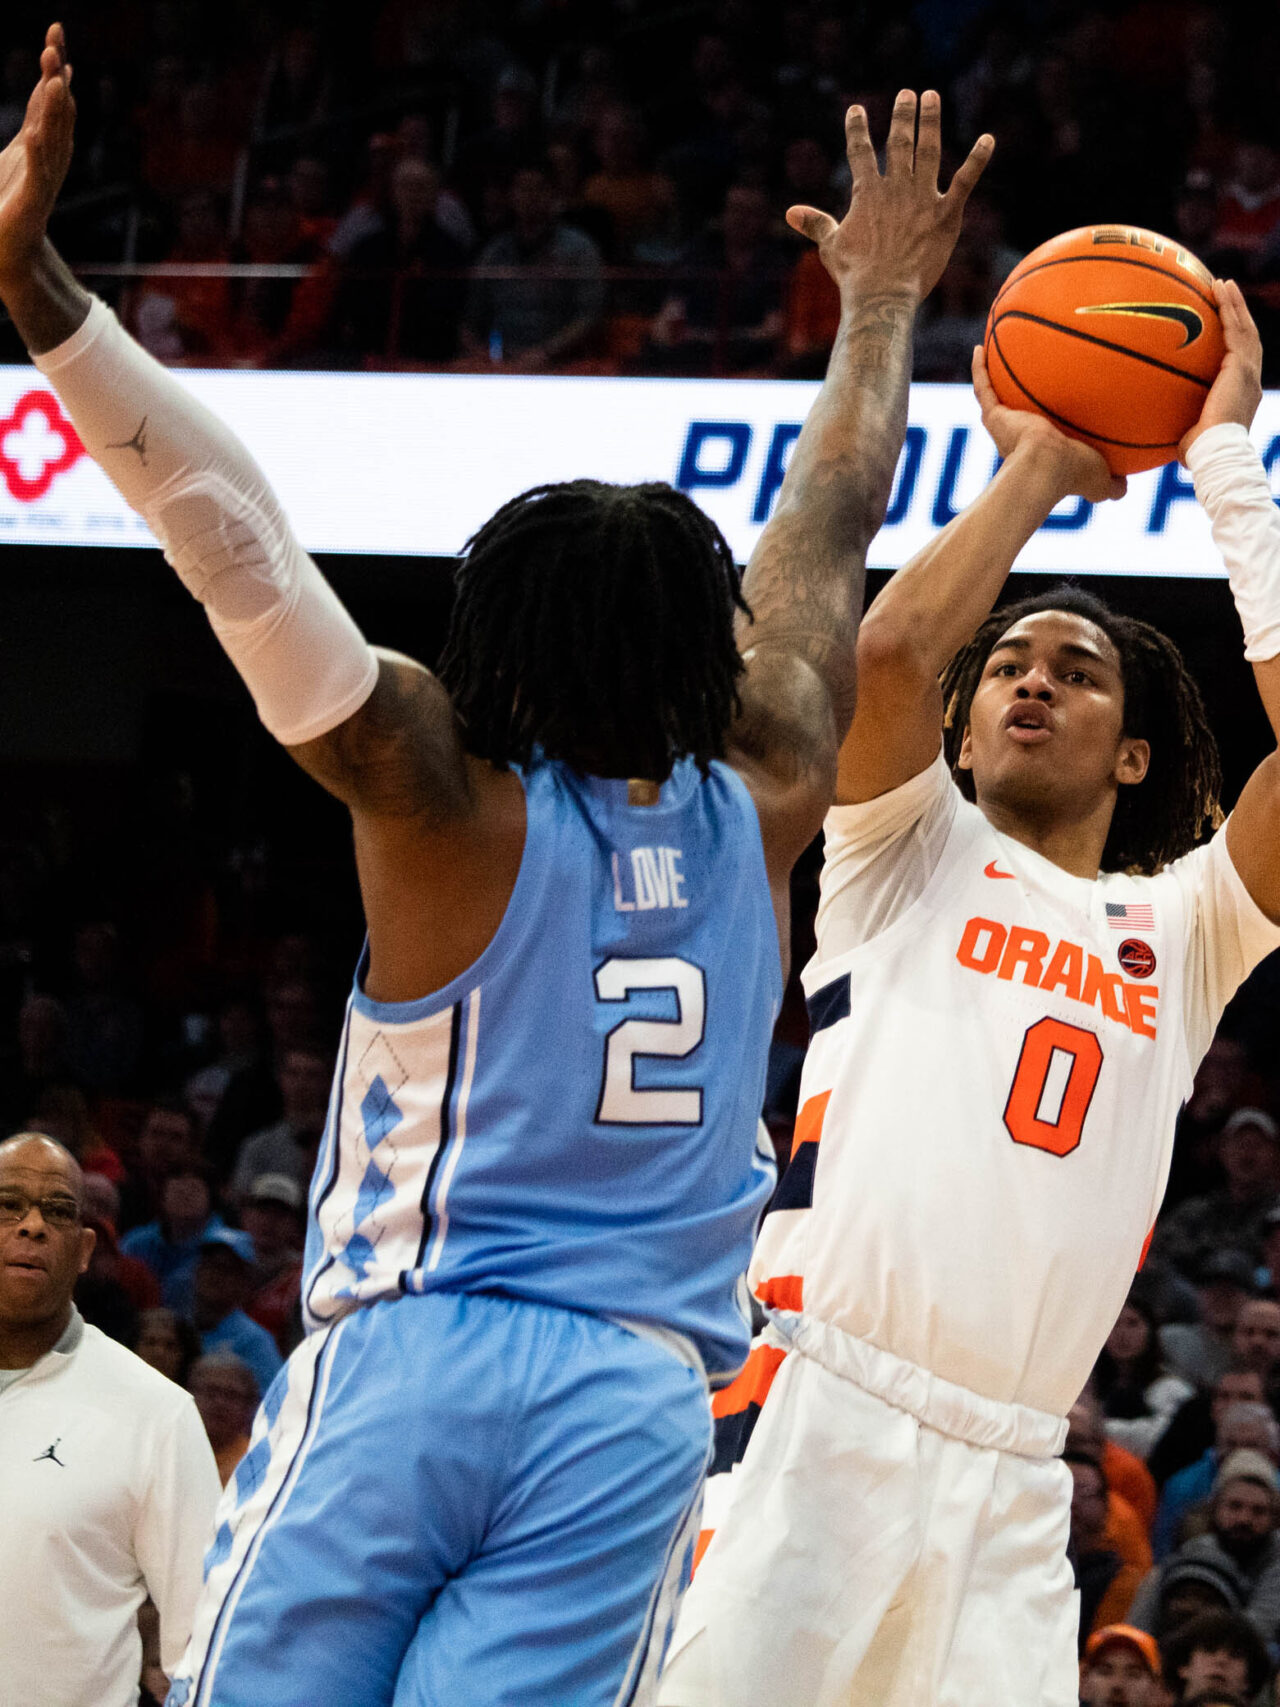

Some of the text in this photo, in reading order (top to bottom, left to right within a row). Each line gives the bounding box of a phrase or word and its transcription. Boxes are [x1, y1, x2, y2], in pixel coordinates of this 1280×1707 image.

[611, 846, 689, 912] LOVE
[593, 955, 706, 1126] 2
[1002, 1015, 1104, 1158] 0
